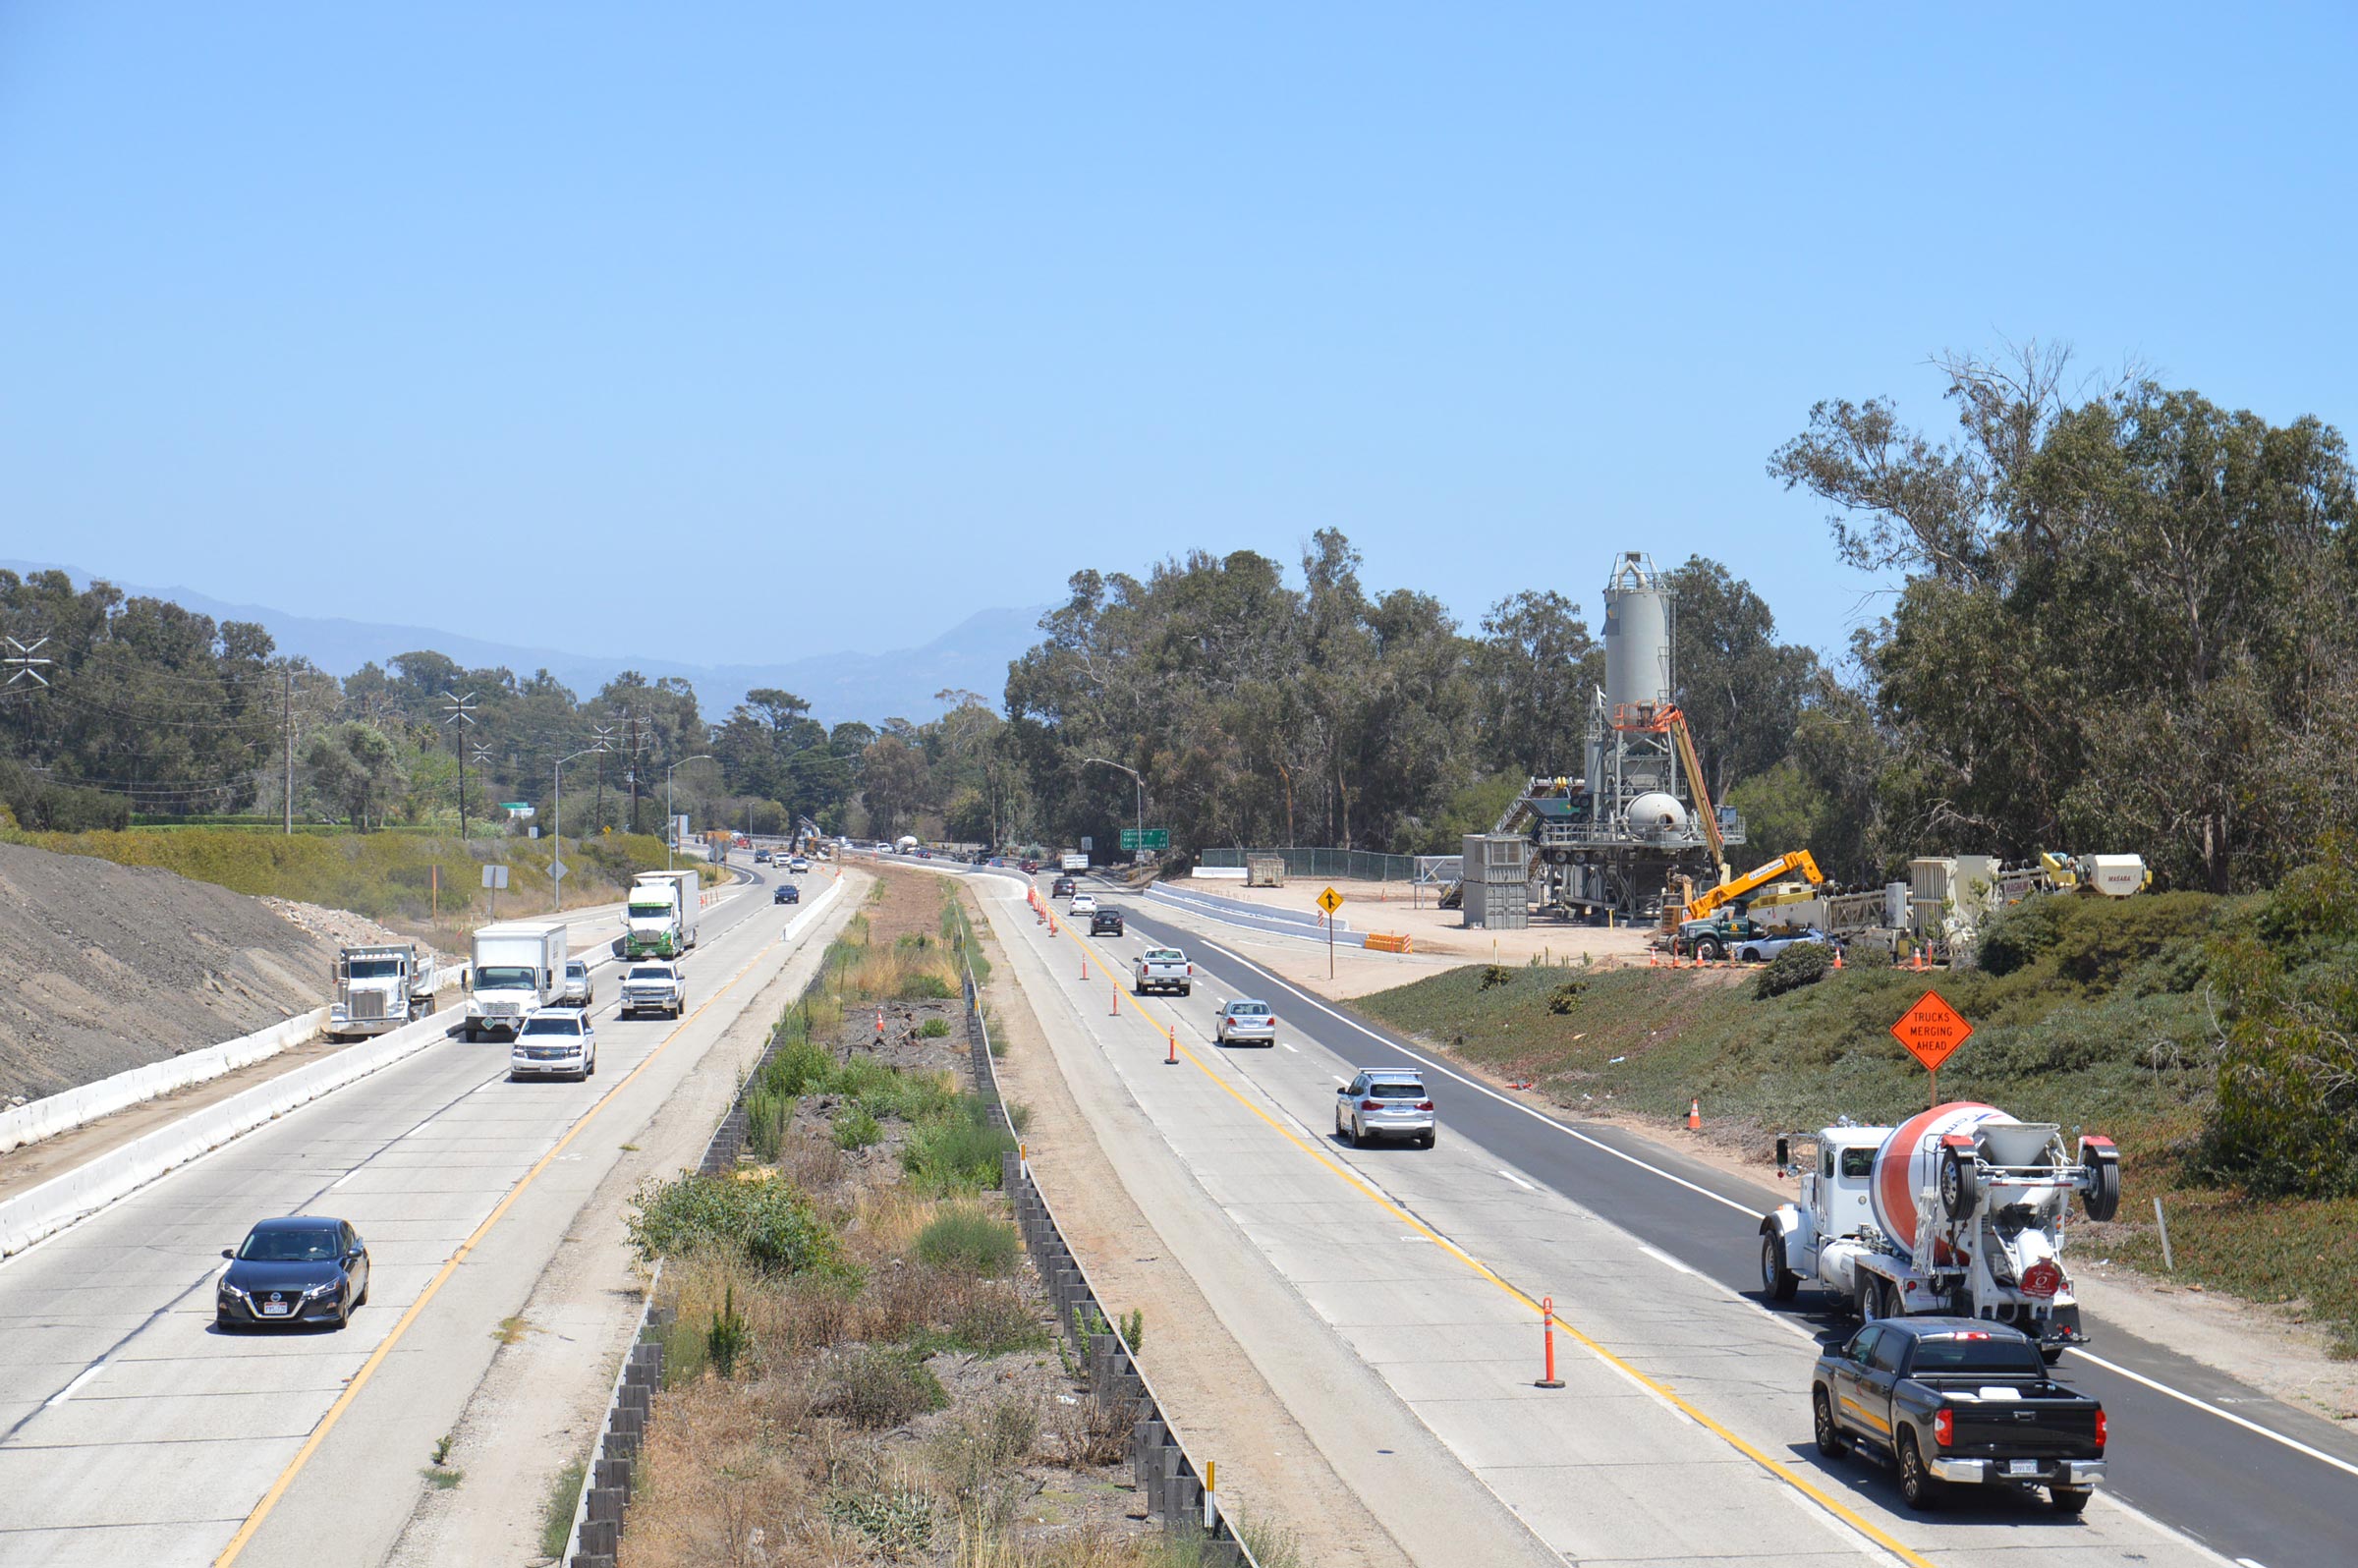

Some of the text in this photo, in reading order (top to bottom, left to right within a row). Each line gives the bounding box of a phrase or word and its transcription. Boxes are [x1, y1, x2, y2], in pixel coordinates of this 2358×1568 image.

[1914, 1012, 1950, 1023] TRUCKS
[1910, 1026, 1953, 1036] MERGING
[1916, 1040, 1947, 1050] AHEAD
